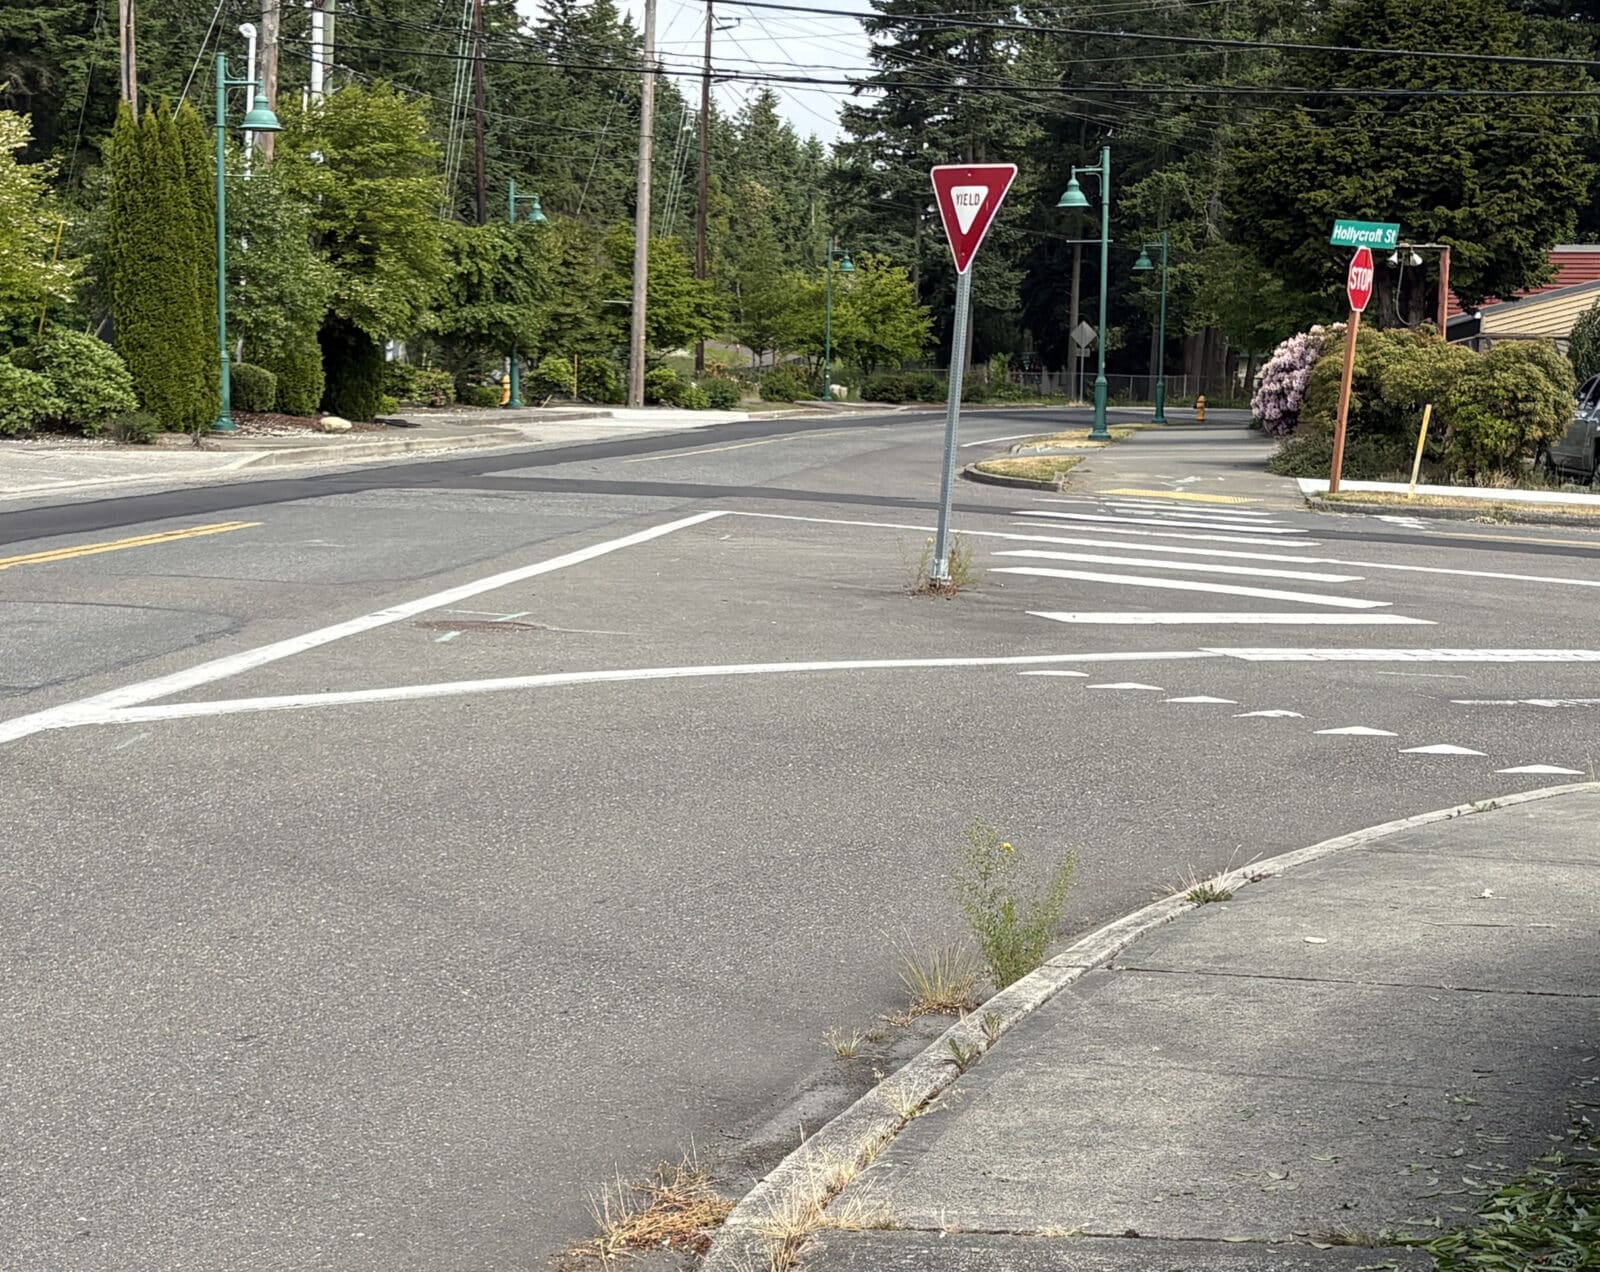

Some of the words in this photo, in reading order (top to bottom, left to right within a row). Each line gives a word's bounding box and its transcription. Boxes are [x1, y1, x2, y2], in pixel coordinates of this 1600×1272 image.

[956, 193, 980, 206] YIELD
[1333, 225, 1383, 244] Hollycroft
[1384, 229, 1396, 244] St
[1350, 267, 1372, 291] STOP
